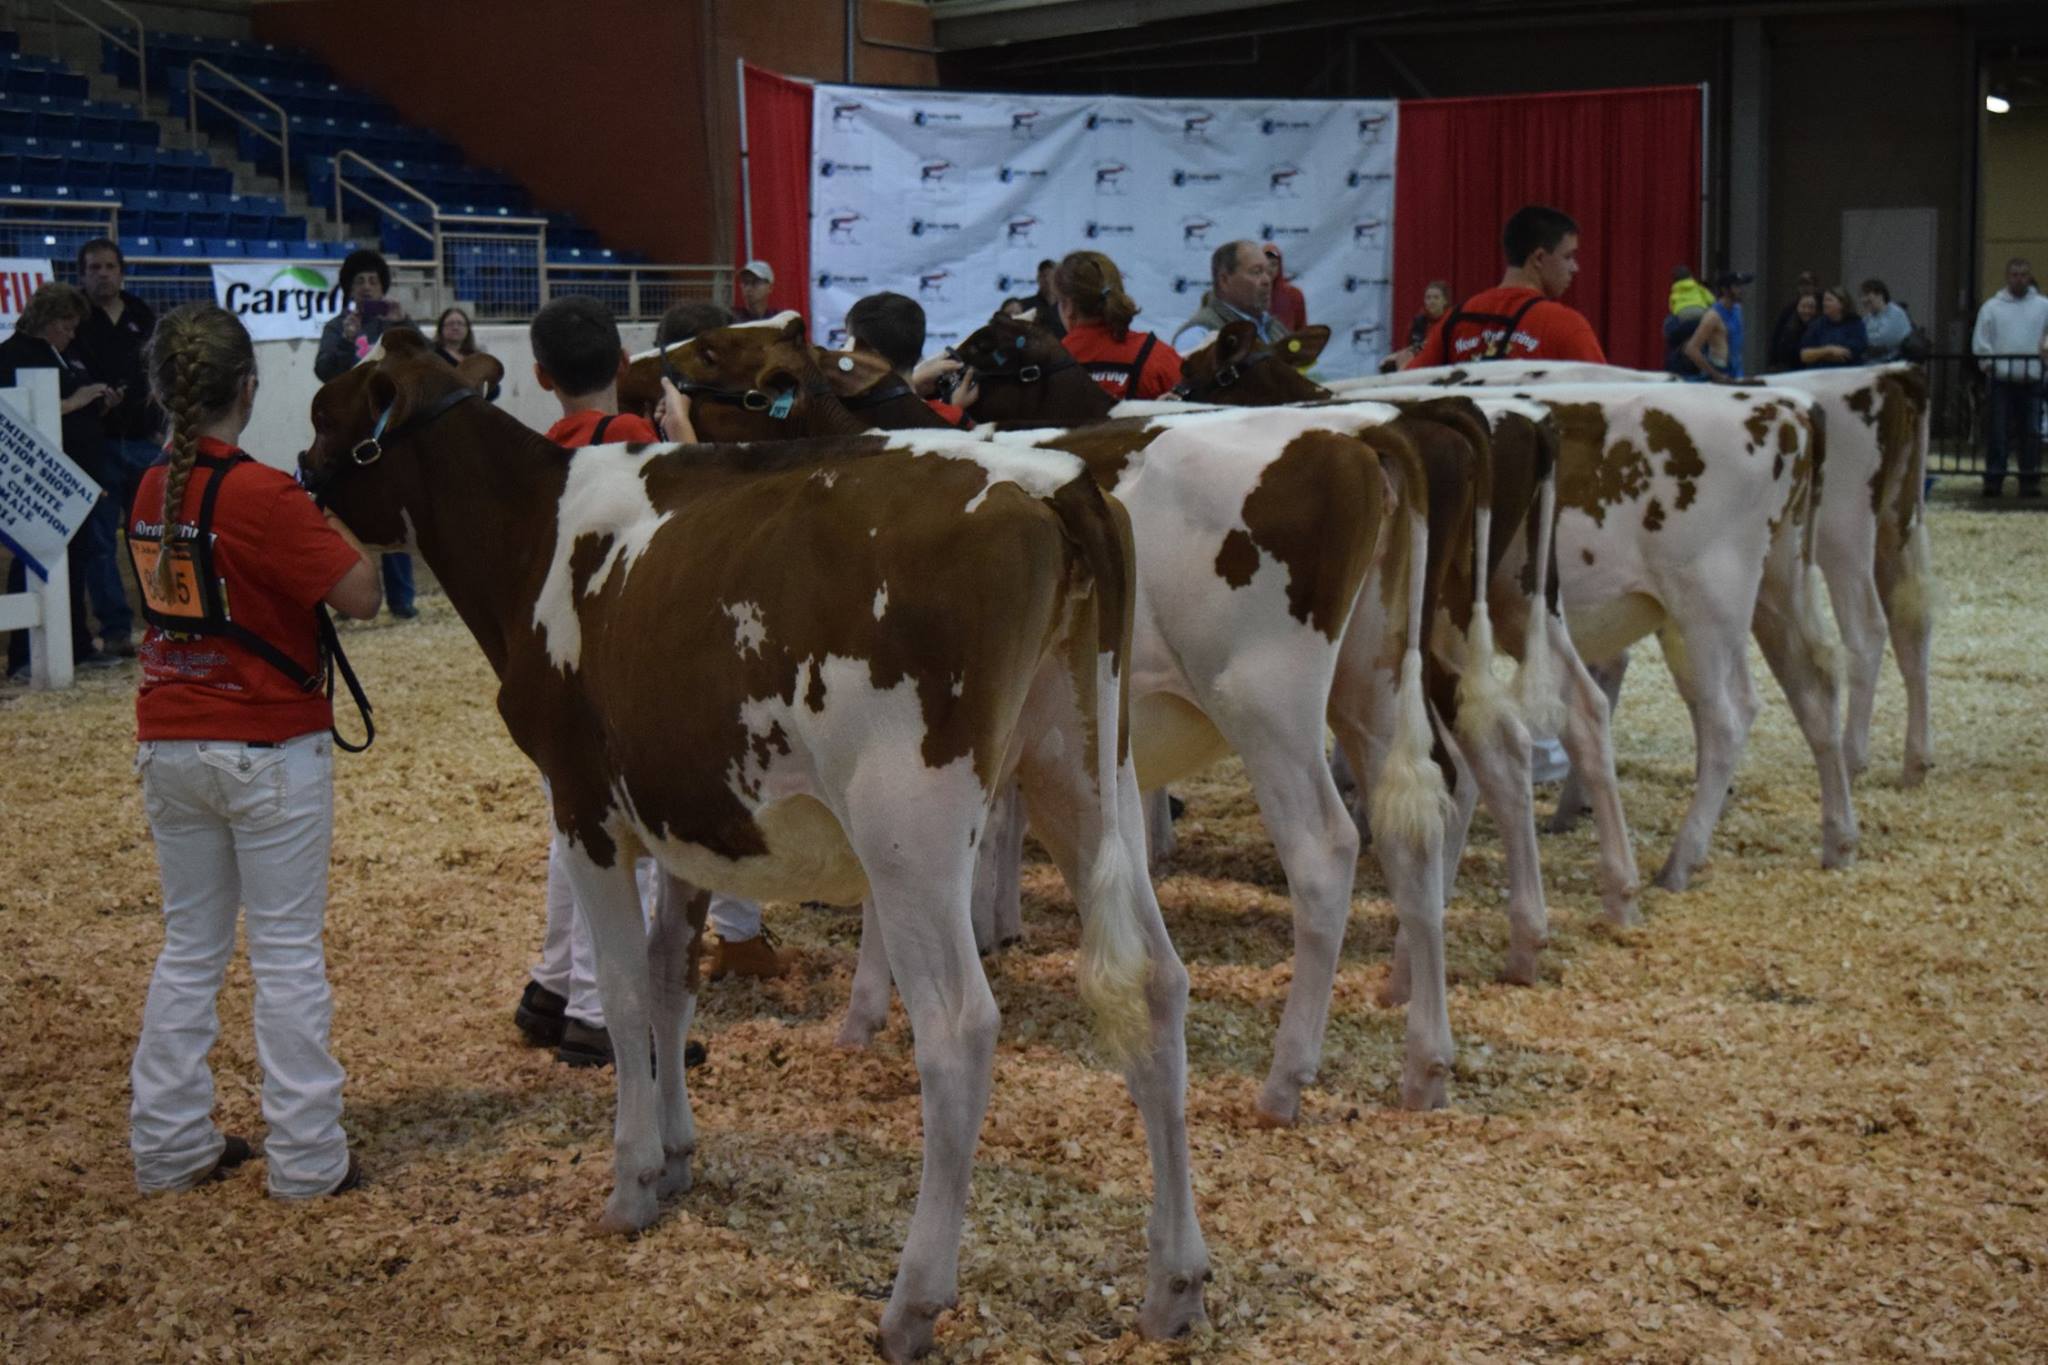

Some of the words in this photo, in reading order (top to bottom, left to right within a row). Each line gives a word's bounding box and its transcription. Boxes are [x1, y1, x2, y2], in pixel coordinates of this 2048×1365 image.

[226, 282, 342, 320] Cargil
[24, 472, 64, 513] WHITE
[37, 447, 94, 504] NATIONAL
[38, 465, 73, 499] SHOW
[7, 479, 70, 537] CHAMPION
